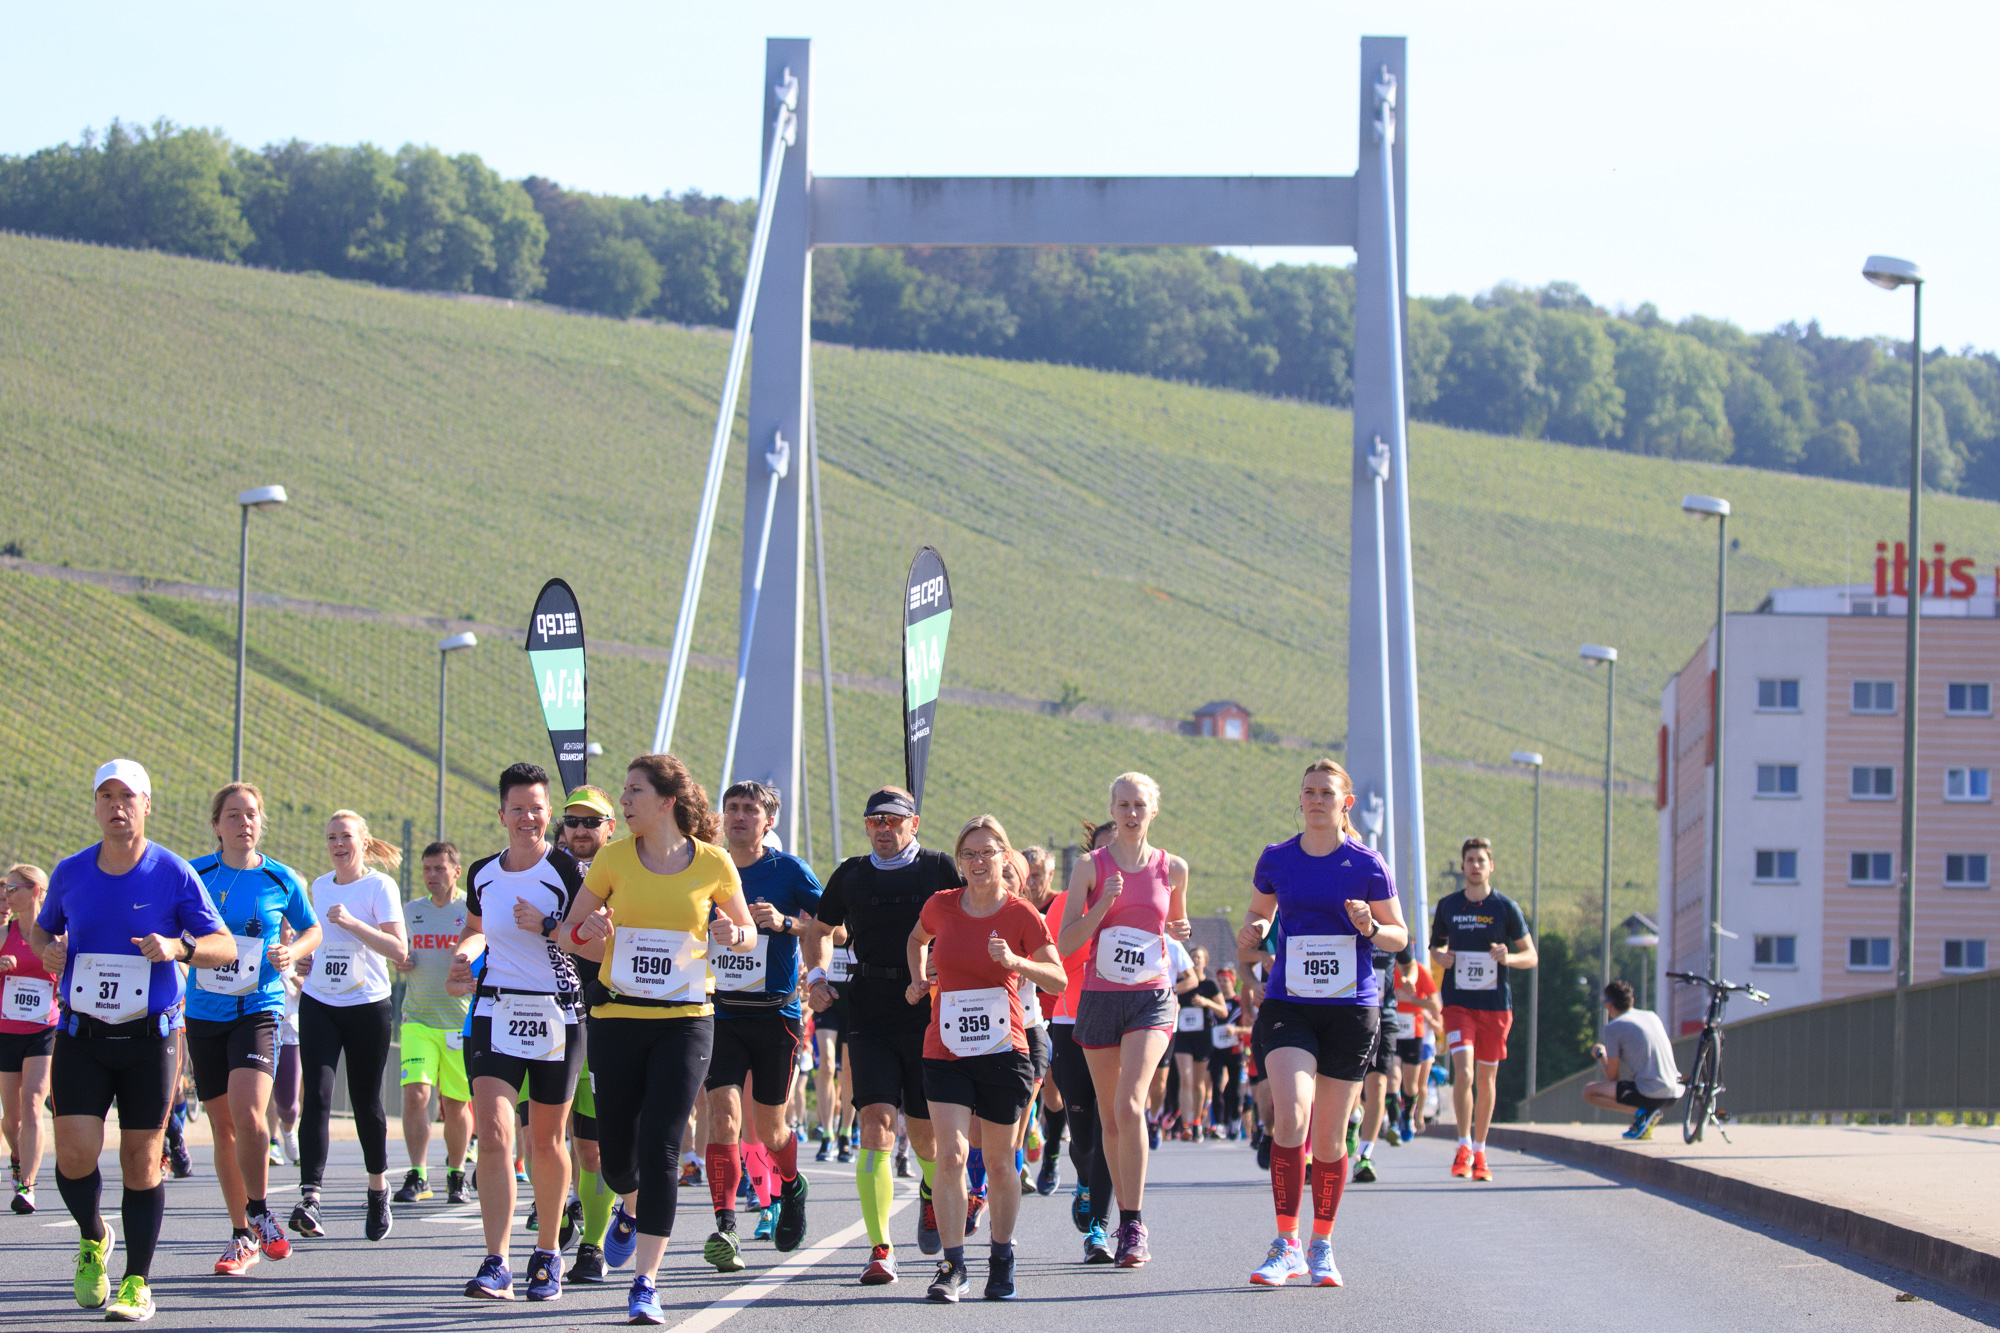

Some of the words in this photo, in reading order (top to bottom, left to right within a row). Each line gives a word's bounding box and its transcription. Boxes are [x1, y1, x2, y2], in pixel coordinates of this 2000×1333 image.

[1875, 541, 1977, 600] ibis
[921, 575, 943, 607] cep
[907, 635, 941, 686] 4:14
[1453, 915, 1494, 924] PENTADOC
[636, 945, 670, 954] Halbmarathon
[717, 954, 754, 971] 10255
[1113, 947, 1145, 967] 2114
[325, 962, 348, 976] 802
[631, 955, 672, 976] 1590
[1120, 965, 1135, 974] Katja
[1302, 959, 1340, 976] 1953
[1467, 966, 1484, 977] 270
[215, 974, 234, 982] Sophia
[635, 976, 665, 985] Stavroula
[1313, 977, 1329, 985] Emmi
[99, 981, 119, 1000] 37
[14, 993, 40, 1007] 1099
[95, 1001, 121, 1010] Michael
[508, 1020, 548, 1038] 2234
[958, 1014, 990, 1034] 359
[521, 1039, 535, 1047] Ines
[960, 1033, 991, 1043] Alexandra
